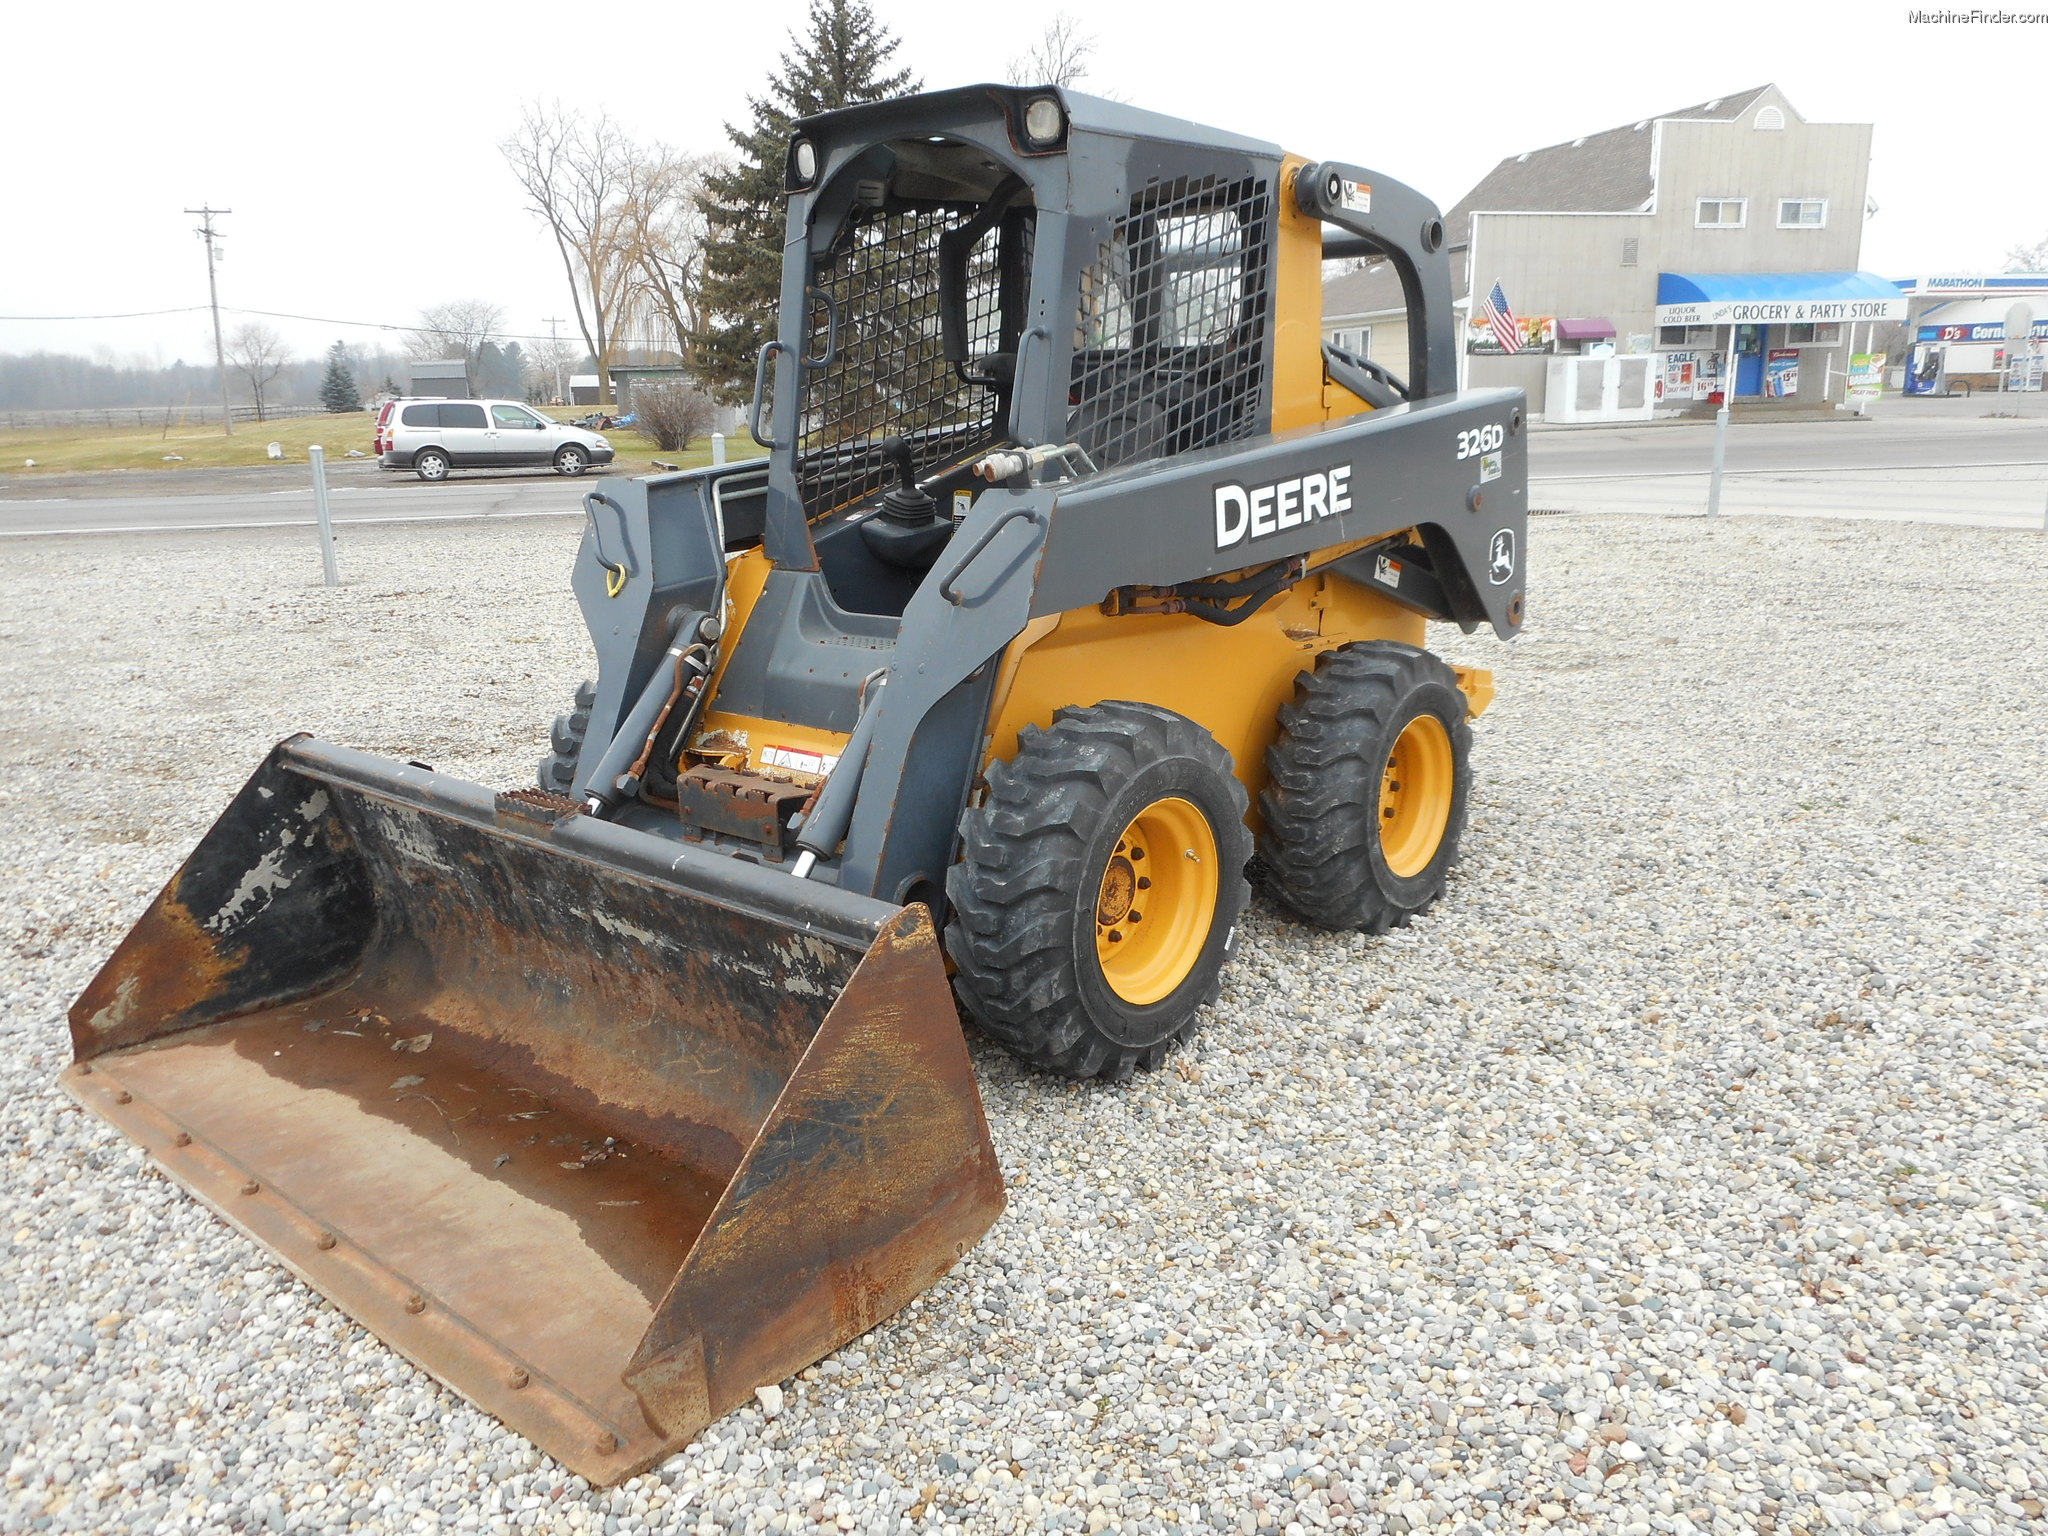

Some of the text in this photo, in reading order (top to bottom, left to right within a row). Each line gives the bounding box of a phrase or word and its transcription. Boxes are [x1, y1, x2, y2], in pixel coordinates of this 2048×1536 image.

[1927, 278, 1983, 288] MARATHON
[1669, 306, 1696, 315] LIQUOR
[1733, 304, 1791, 320] GROCERY
[1795, 304, 1805, 319] &
[1810, 303, 1847, 318] PARTY
[1851, 302, 1888, 318] STORE
[1663, 316, 1682, 324] COLD
[1943, 326, 1961, 340] D's
[1667, 352, 1694, 364] EAGLE
[1456, 424, 1504, 460] 326D
[1215, 465, 1352, 548] DEERE
